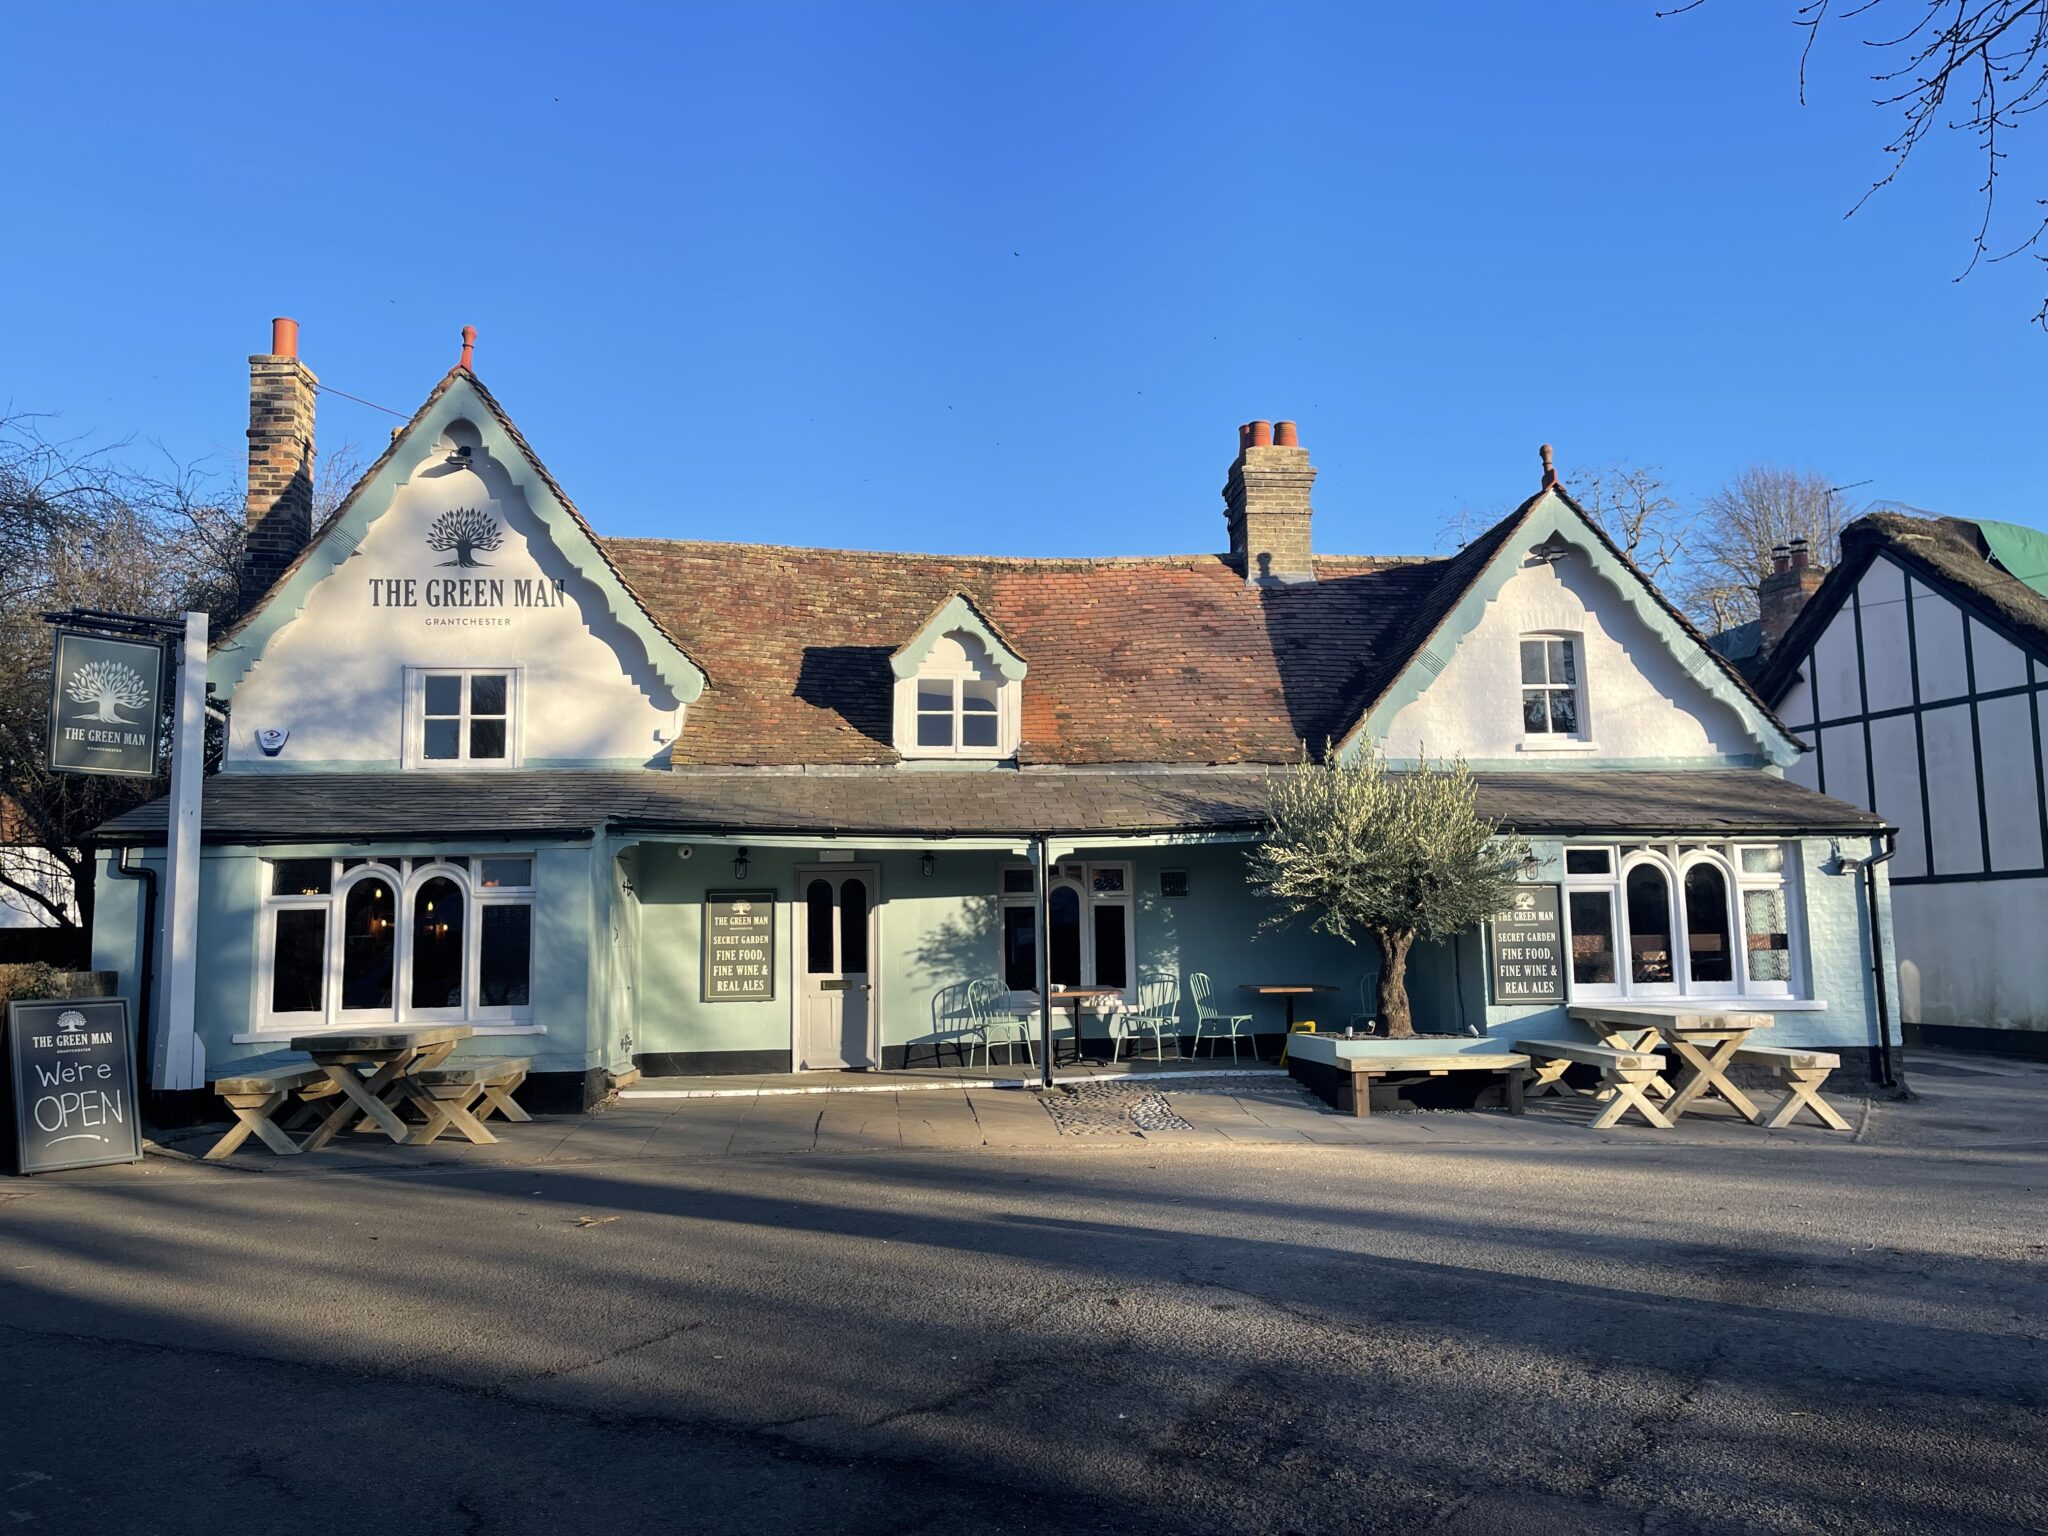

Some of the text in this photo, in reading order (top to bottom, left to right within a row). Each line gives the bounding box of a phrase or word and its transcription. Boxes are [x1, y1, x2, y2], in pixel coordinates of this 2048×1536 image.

[369, 578, 565, 608] THE GREEN MAN
[425, 618, 511, 626] GRANTCHESTER
[64, 727, 146, 746] THE GREEN MAN
[714, 916, 769, 926] THE GREEN MAN
[1514, 911, 1537, 921] GREEN
[1538, 911, 1554, 921] MAN
[713, 935, 769, 945] SECRET GARDEN
[1498, 932, 1556, 942] SECRET GARDEN
[716, 949, 766, 962] FINE FOOD,
[1502, 947, 1554, 961] FINE FOOD,
[713, 964, 769, 976] FINE WINE &
[1500, 964, 1558, 977] FINE WINE &
[717, 979, 765, 992] REAL ALES
[1505, 981, 1555, 994] REAL ALES
[32, 1032, 113, 1048] THE GREEN MAN
[35, 1061, 112, 1088] We're
[34, 1089, 123, 1132] OPEN
